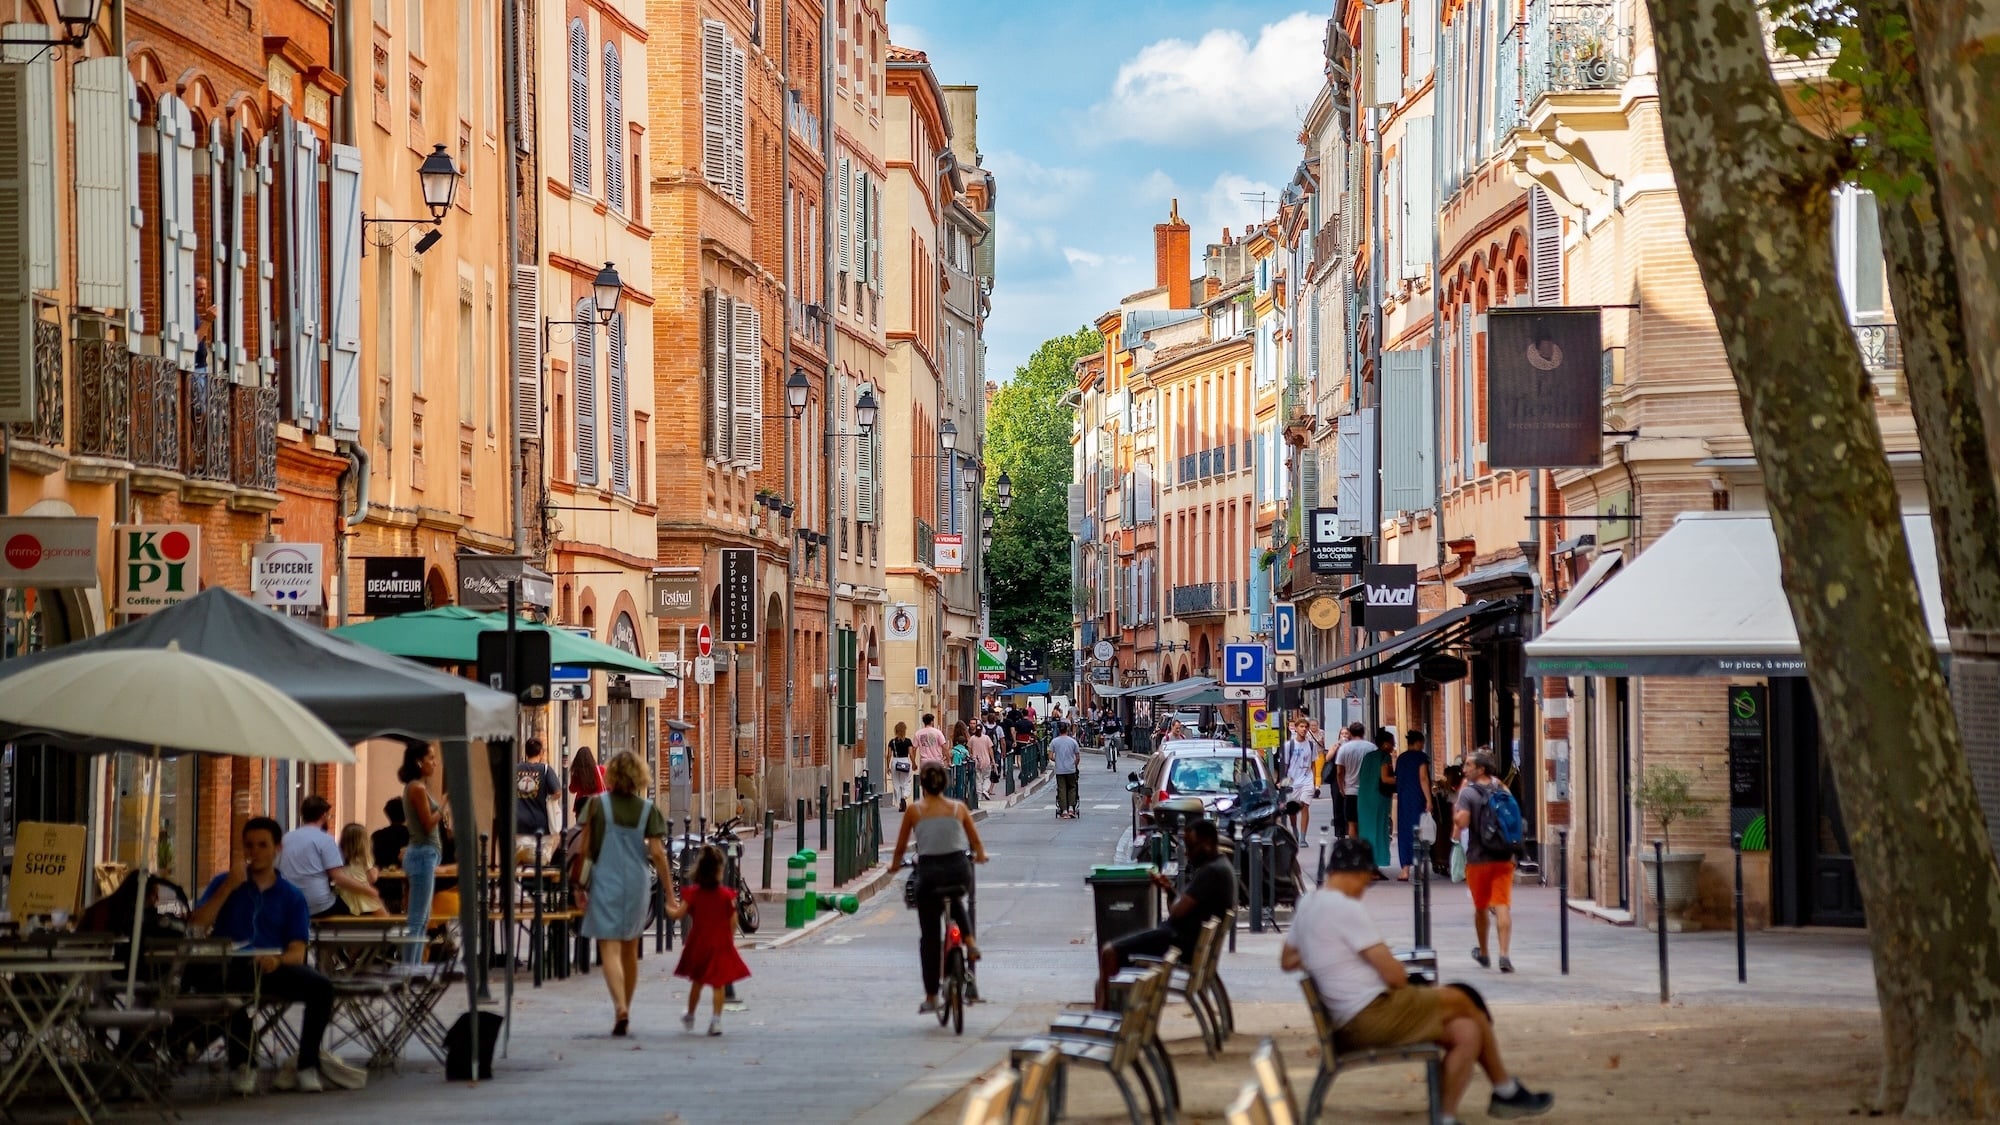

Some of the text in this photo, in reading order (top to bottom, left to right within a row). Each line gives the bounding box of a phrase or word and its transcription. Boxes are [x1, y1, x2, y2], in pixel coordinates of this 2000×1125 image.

[9, 547, 91, 560] immo garonne
[1330, 552, 1354, 561] Copains
[367, 579, 421, 593] DECANTEUR
[126, 597, 162, 605] Coffee
[661, 589, 692, 606] Festival
[1366, 584, 1416, 605] Vival
[1280, 613, 1290, 643] P
[1236, 652, 1253, 677] P
[1719, 660, 1734, 669] Sur
[1736, 660, 1765, 671] place,
[1767, 659, 1773, 669] à
[26, 853, 67, 864] COFFEE
[25, 863, 66, 876] SHOP
